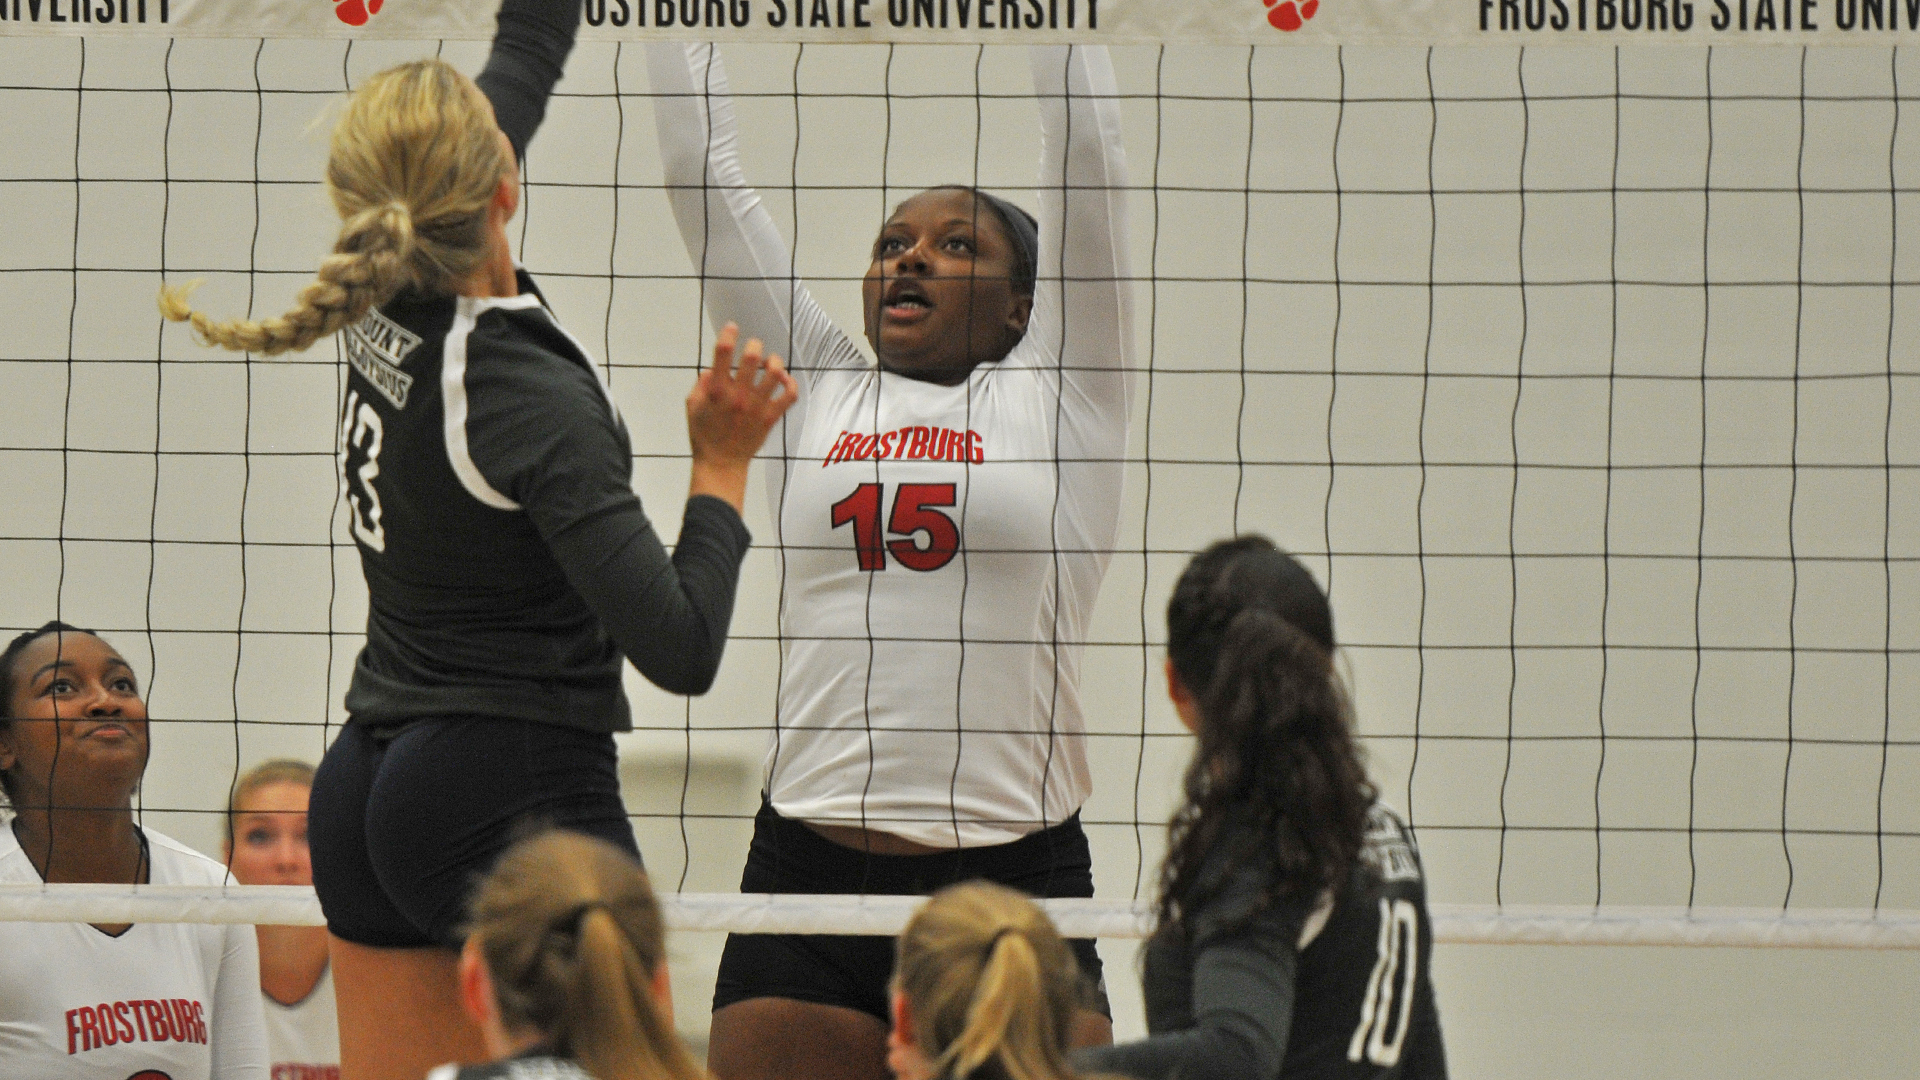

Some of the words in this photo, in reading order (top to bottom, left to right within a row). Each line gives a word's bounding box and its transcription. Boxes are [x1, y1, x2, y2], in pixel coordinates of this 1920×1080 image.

[585, 0, 750, 28] OSTBURG
[767, 0, 872, 28] STATE
[888, 0, 1098, 30] UNIVERSITY
[1479, 0, 1694, 31] FROSTBURG
[1710, 0, 1818, 31] STATE
[822, 425, 985, 469] FROSTBURG
[831, 482, 961, 572] 15
[1347, 897, 1418, 1067] 10
[65, 998, 208, 1055] FROSTBURG
